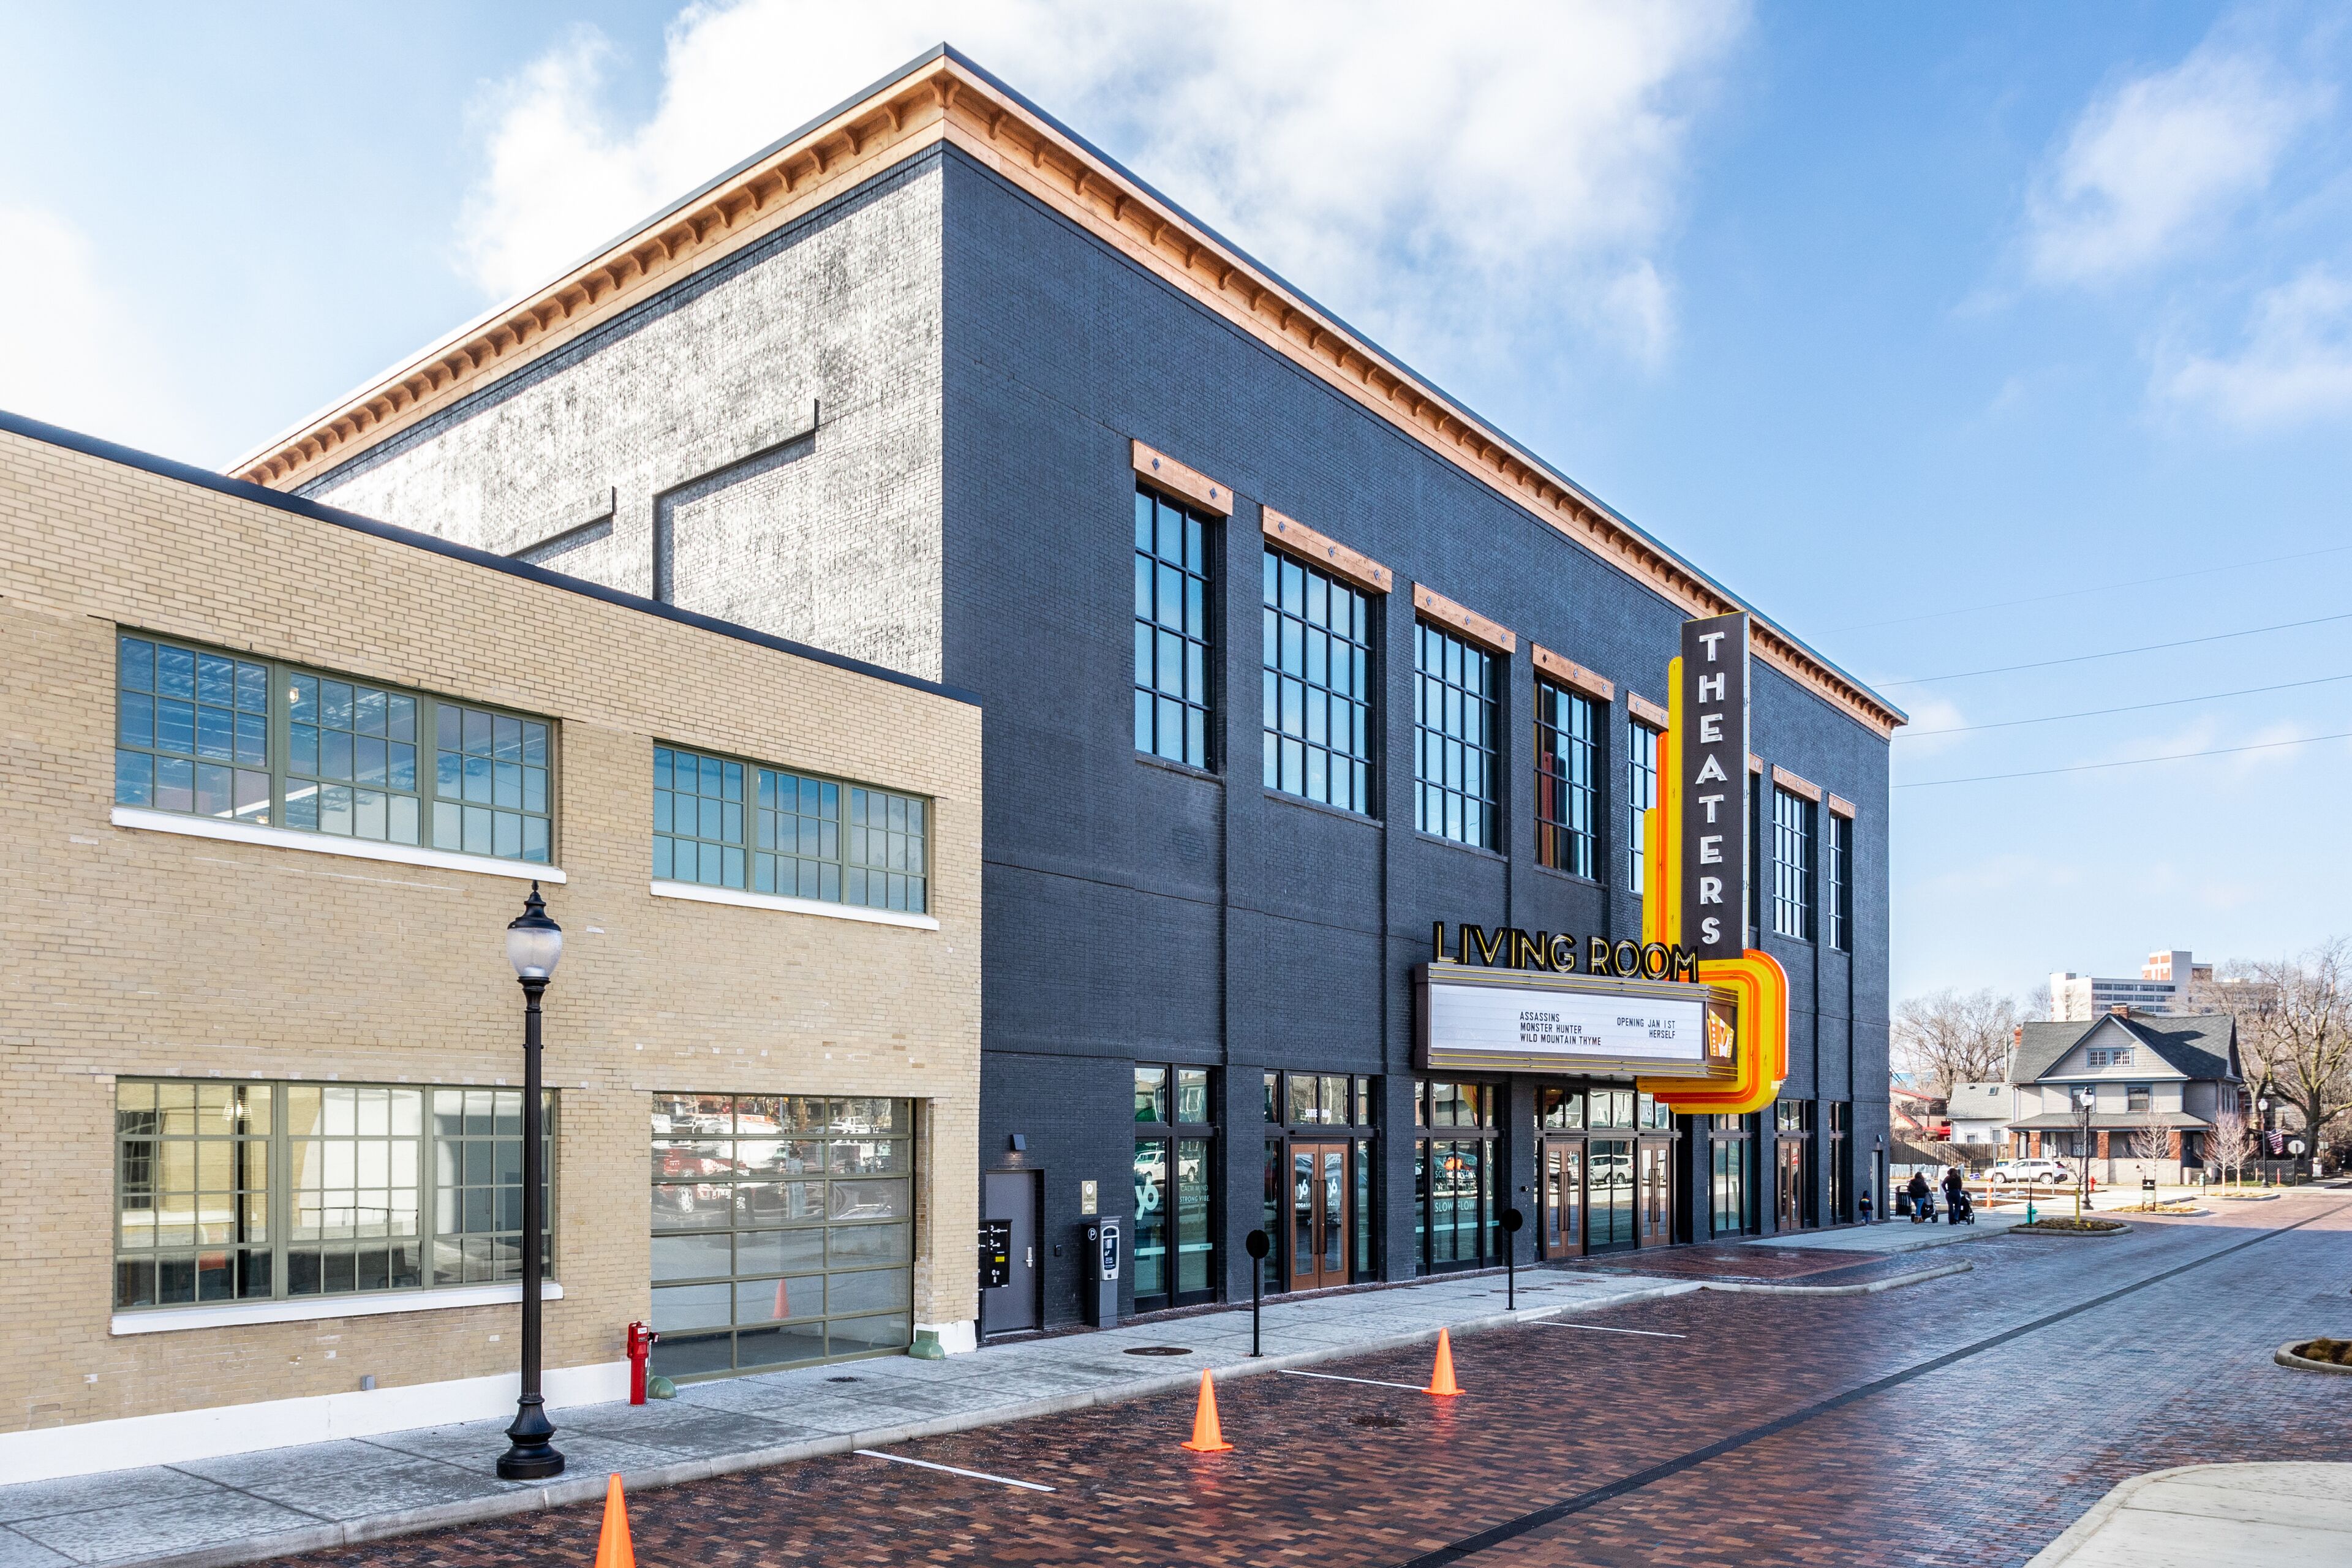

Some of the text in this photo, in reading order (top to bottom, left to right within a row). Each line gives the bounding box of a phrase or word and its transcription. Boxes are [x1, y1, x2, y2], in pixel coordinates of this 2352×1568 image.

[1695, 631, 1727, 945] THEATERS
[1433, 921, 1699, 984] LIVING ROOM
[1520, 1011, 1560, 1022] ASSASSINS
[1616, 1017, 1644, 1027] OPENING
[1648, 1019, 1660, 1028] JAN
[1520, 1022, 1582, 1035] MONSTER HUNTER
[1520, 1033, 1601, 1046] WILD MOUNTAIN THYME
[1649, 1030, 1676, 1039] HERSELF
[1305, 1108, 1318, 1118] SUITE
[1434, 1201, 1453, 1212] SLOW
